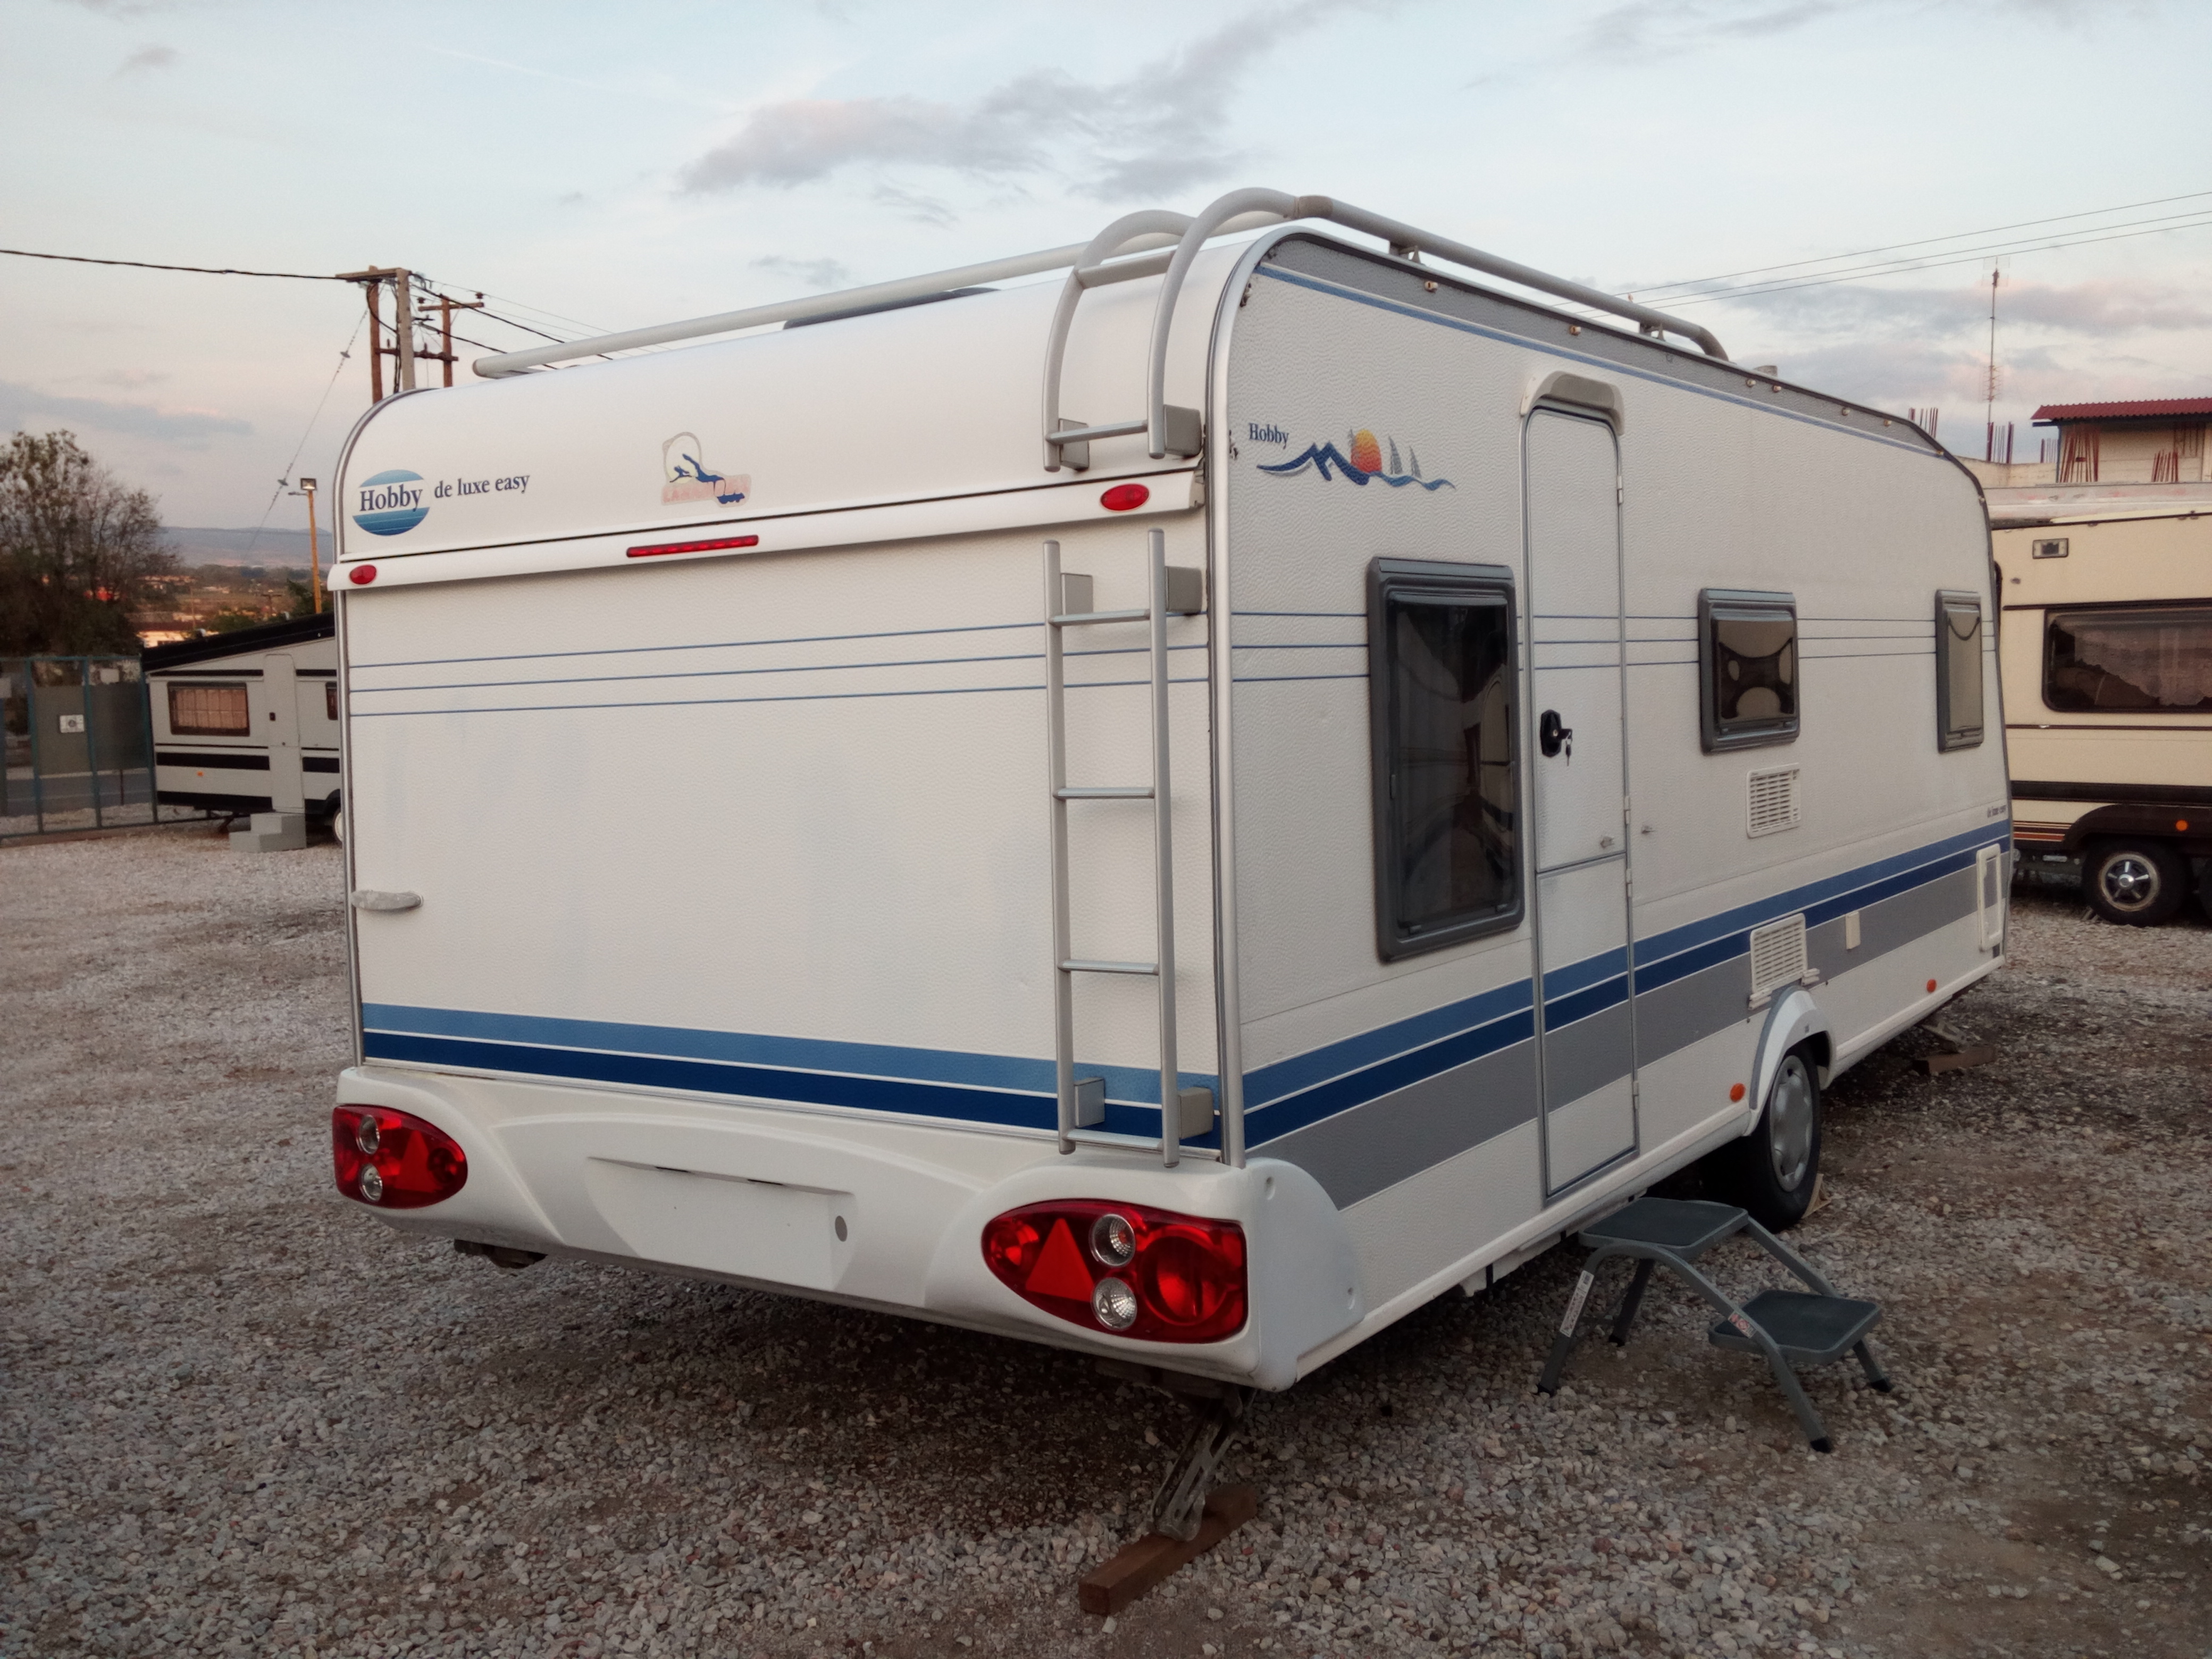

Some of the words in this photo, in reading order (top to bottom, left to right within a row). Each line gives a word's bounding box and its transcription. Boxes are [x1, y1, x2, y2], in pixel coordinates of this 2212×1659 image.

[1249, 423, 1289, 449] Hobby
[359, 484, 423, 512] Hobby
[434, 481, 453, 498] de
[457, 477, 490, 496] luxe
[495, 475, 530, 493] easy
